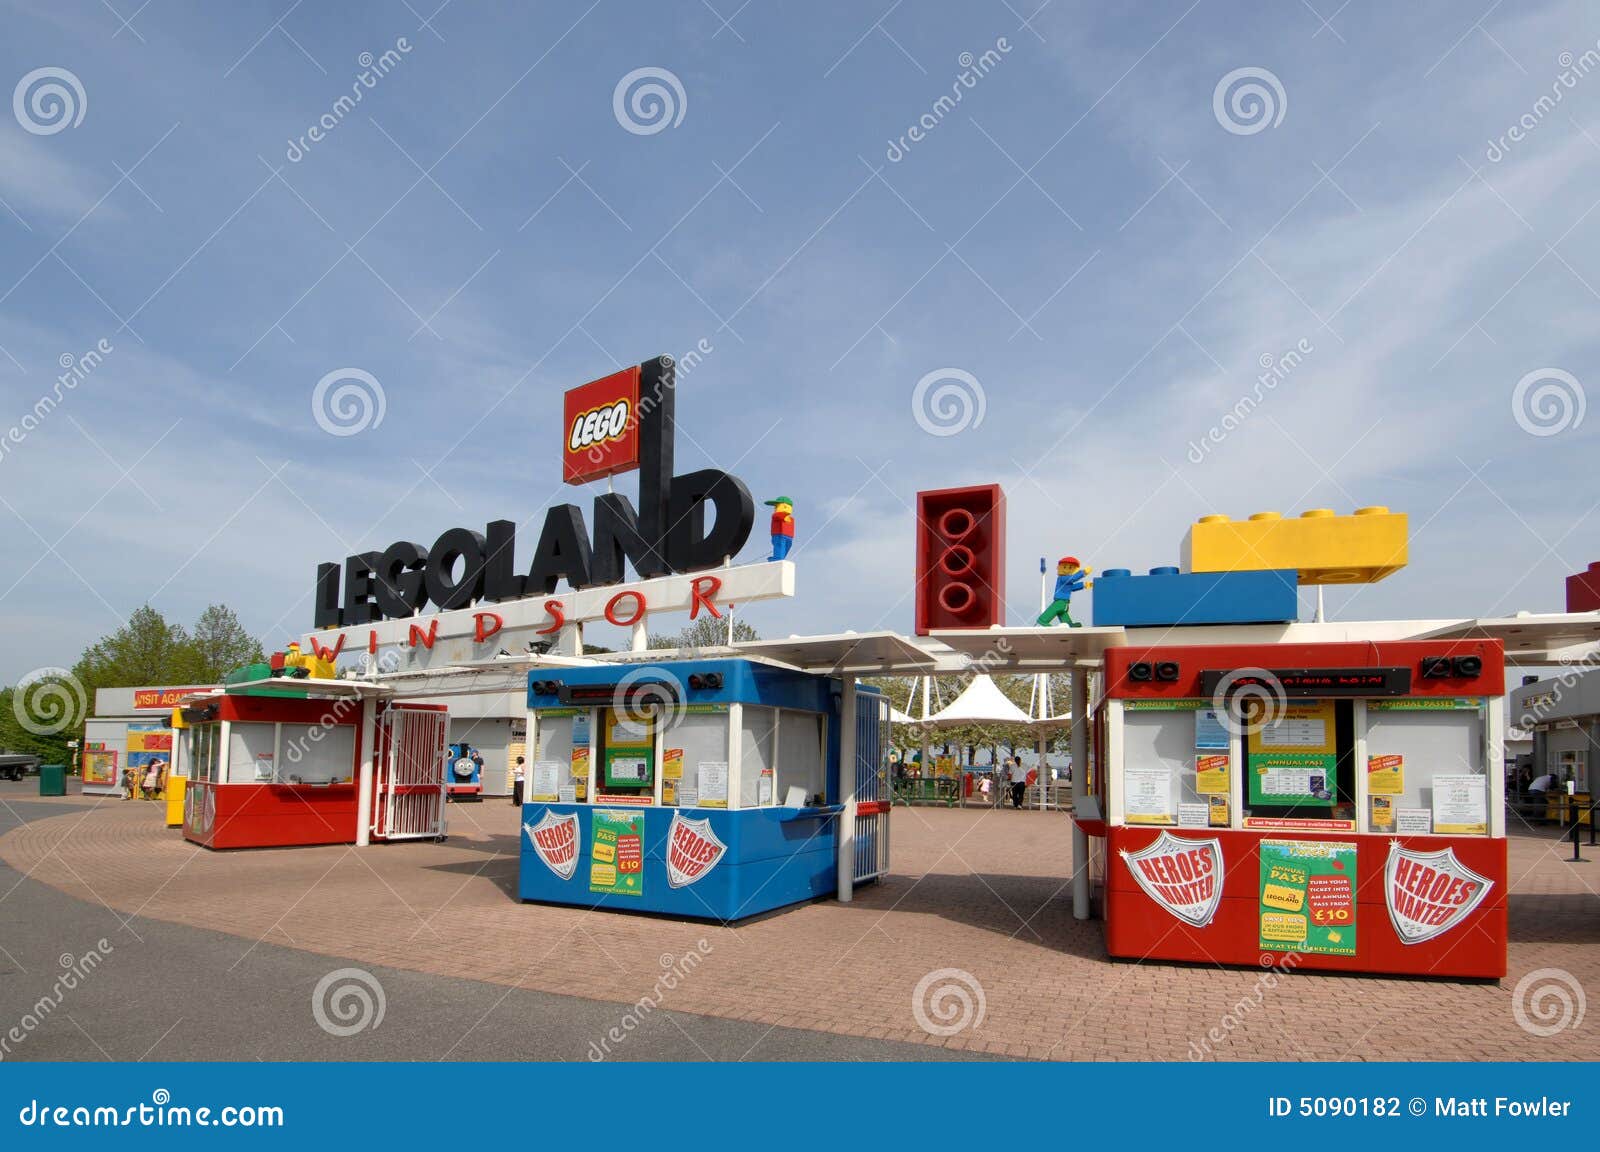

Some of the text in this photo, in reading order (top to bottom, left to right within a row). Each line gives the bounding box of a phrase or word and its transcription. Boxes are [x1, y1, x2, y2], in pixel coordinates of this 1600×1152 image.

[570, 402, 627, 450] LEGO
[314, 354, 755, 629] LEGOLAND
[310, 575, 722, 664] WINDSOR
[534, 819, 574, 849] HEROES
[620, 861, 640, 870] £10
[1136, 847, 1213, 884] HEROES
[1270, 869, 1305, 884] PASS
[1394, 856, 1477, 906] HEROES
[1151, 874, 1214, 905] WANTED
[1266, 893, 1300, 905] LEGOLAND
[1394, 883, 1458, 926] WANTED
[1315, 909, 1349, 921] £10
